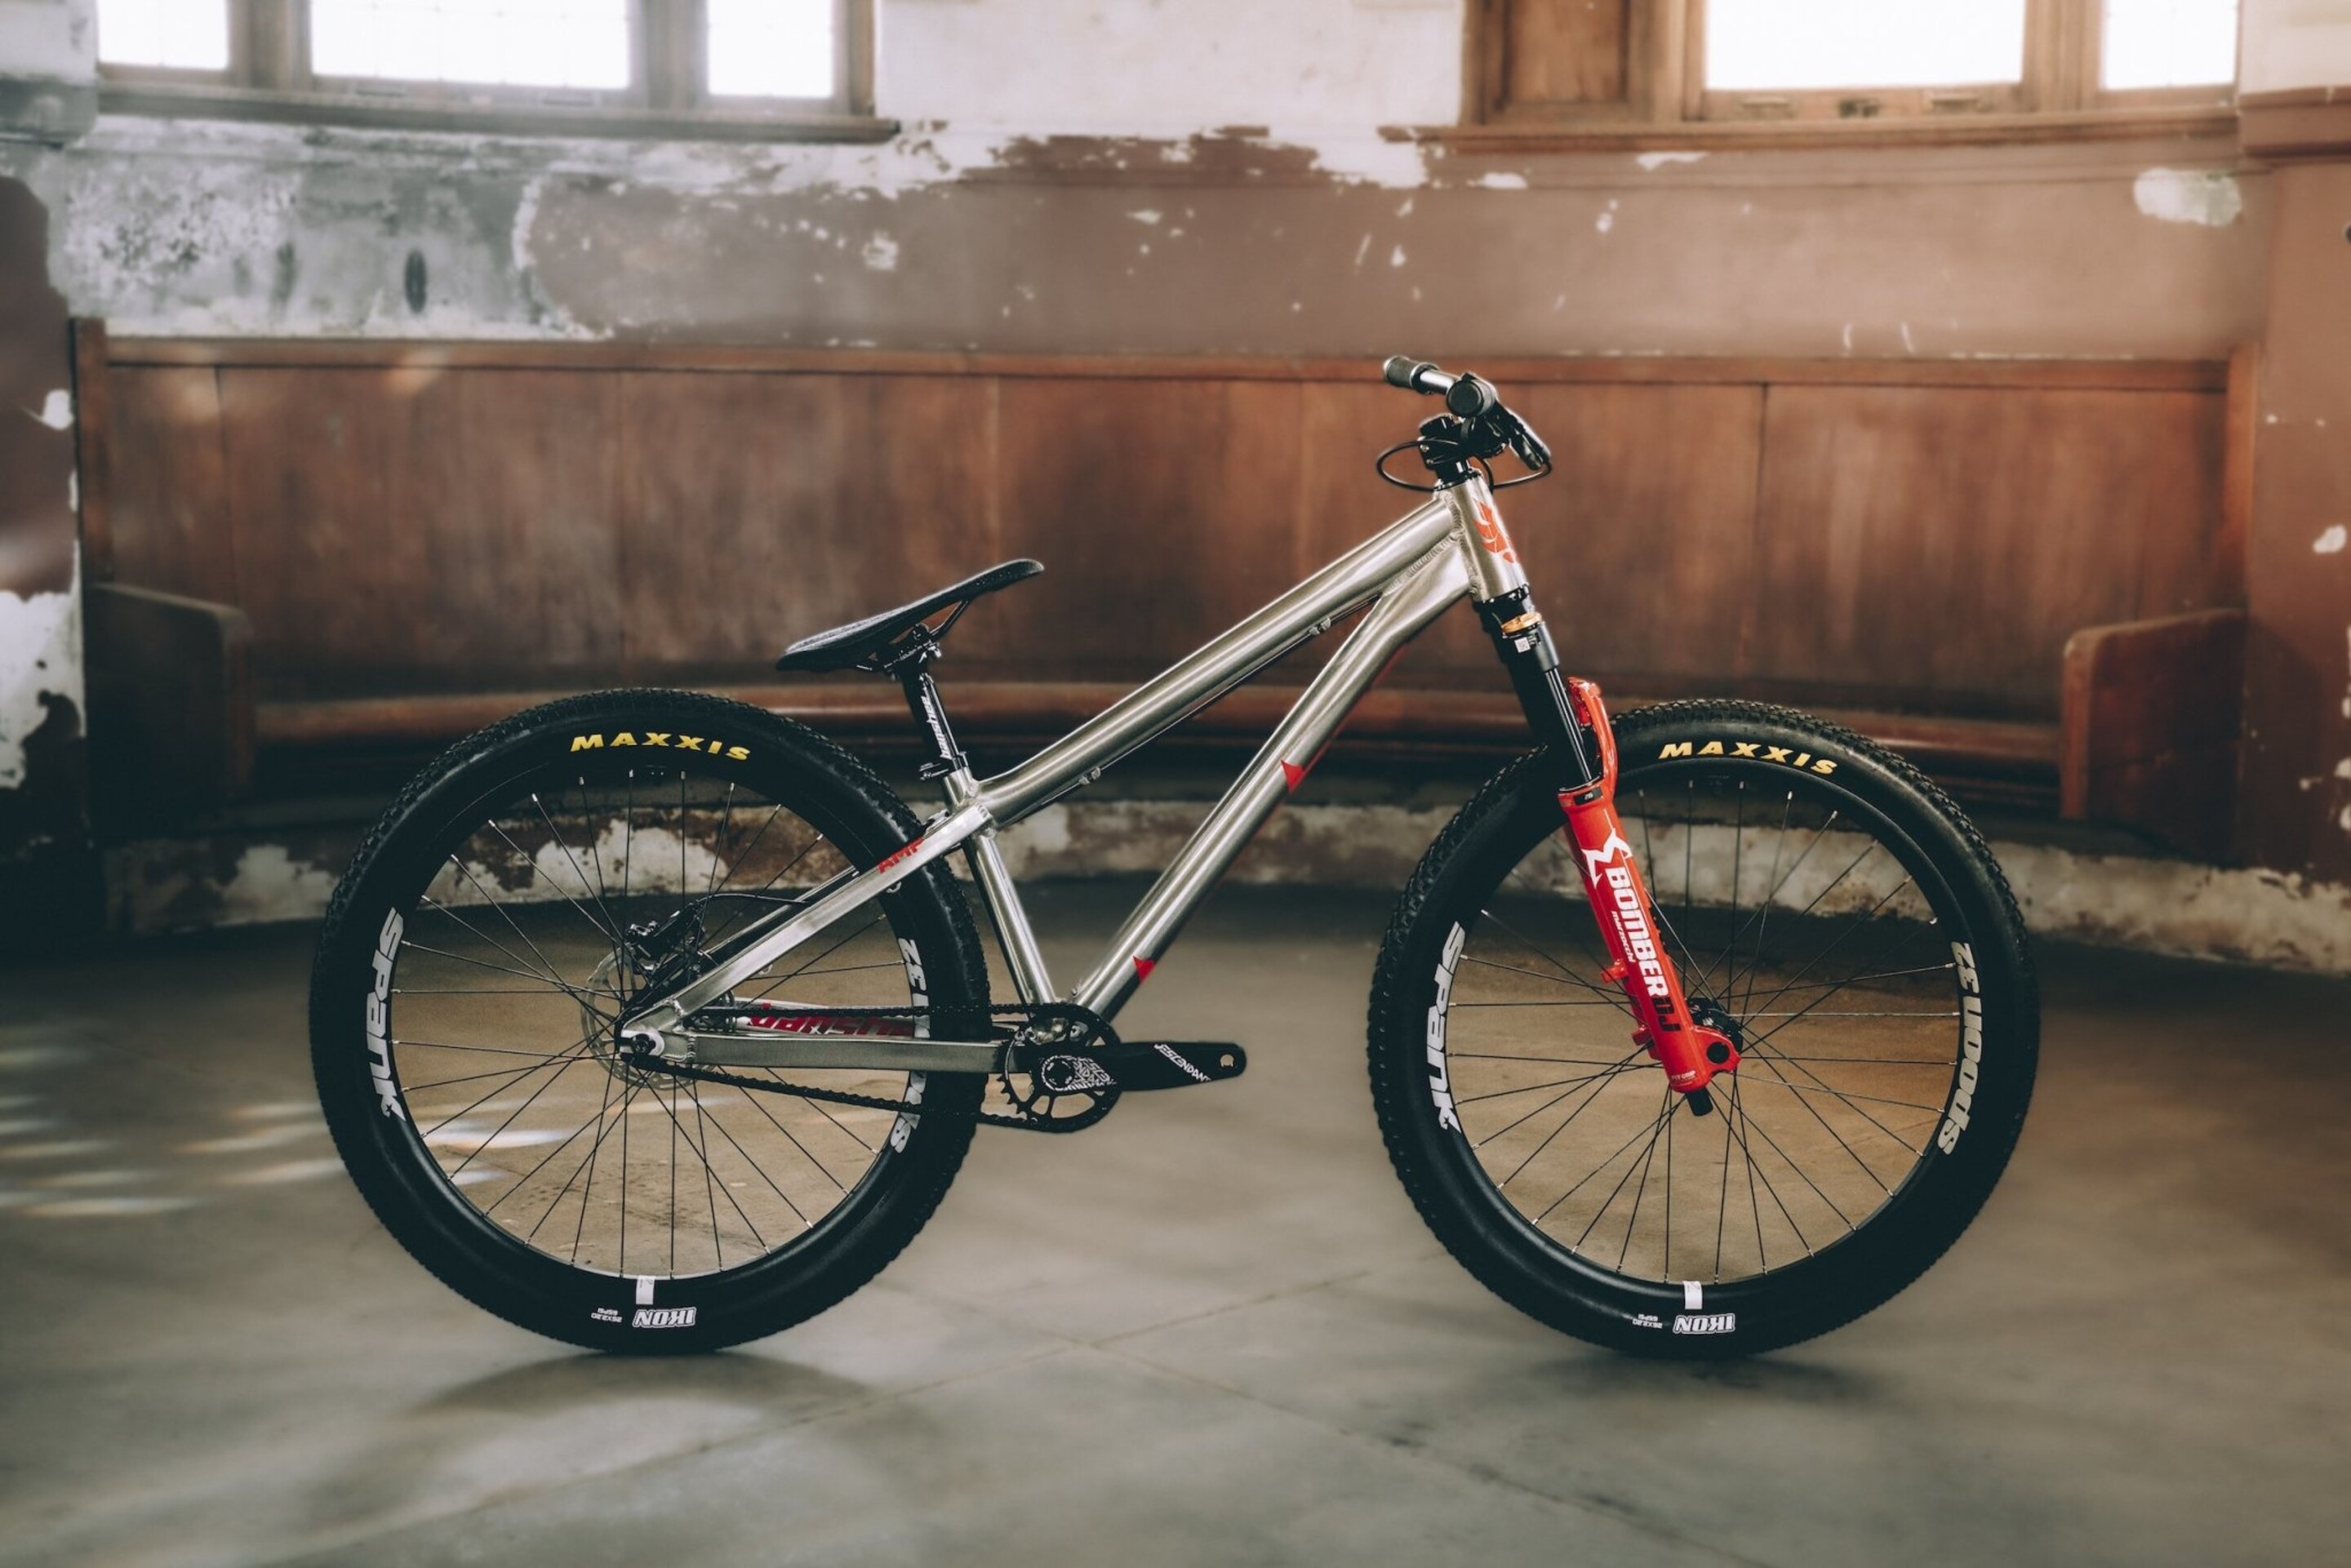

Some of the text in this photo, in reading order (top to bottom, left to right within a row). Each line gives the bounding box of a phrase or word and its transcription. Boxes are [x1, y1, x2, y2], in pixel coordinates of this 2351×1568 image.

[571, 732, 751, 761] MAXXIS
[1658, 741, 1838, 774] MAXXIS
[1605, 867, 1681, 1032] BOMBER DJ
[1611, 910, 1636, 963] marzocchi
[1951, 941, 1980, 994] 32
[633, 1307, 696, 1327] IKON
[1673, 1313, 1735, 1334] IKON
